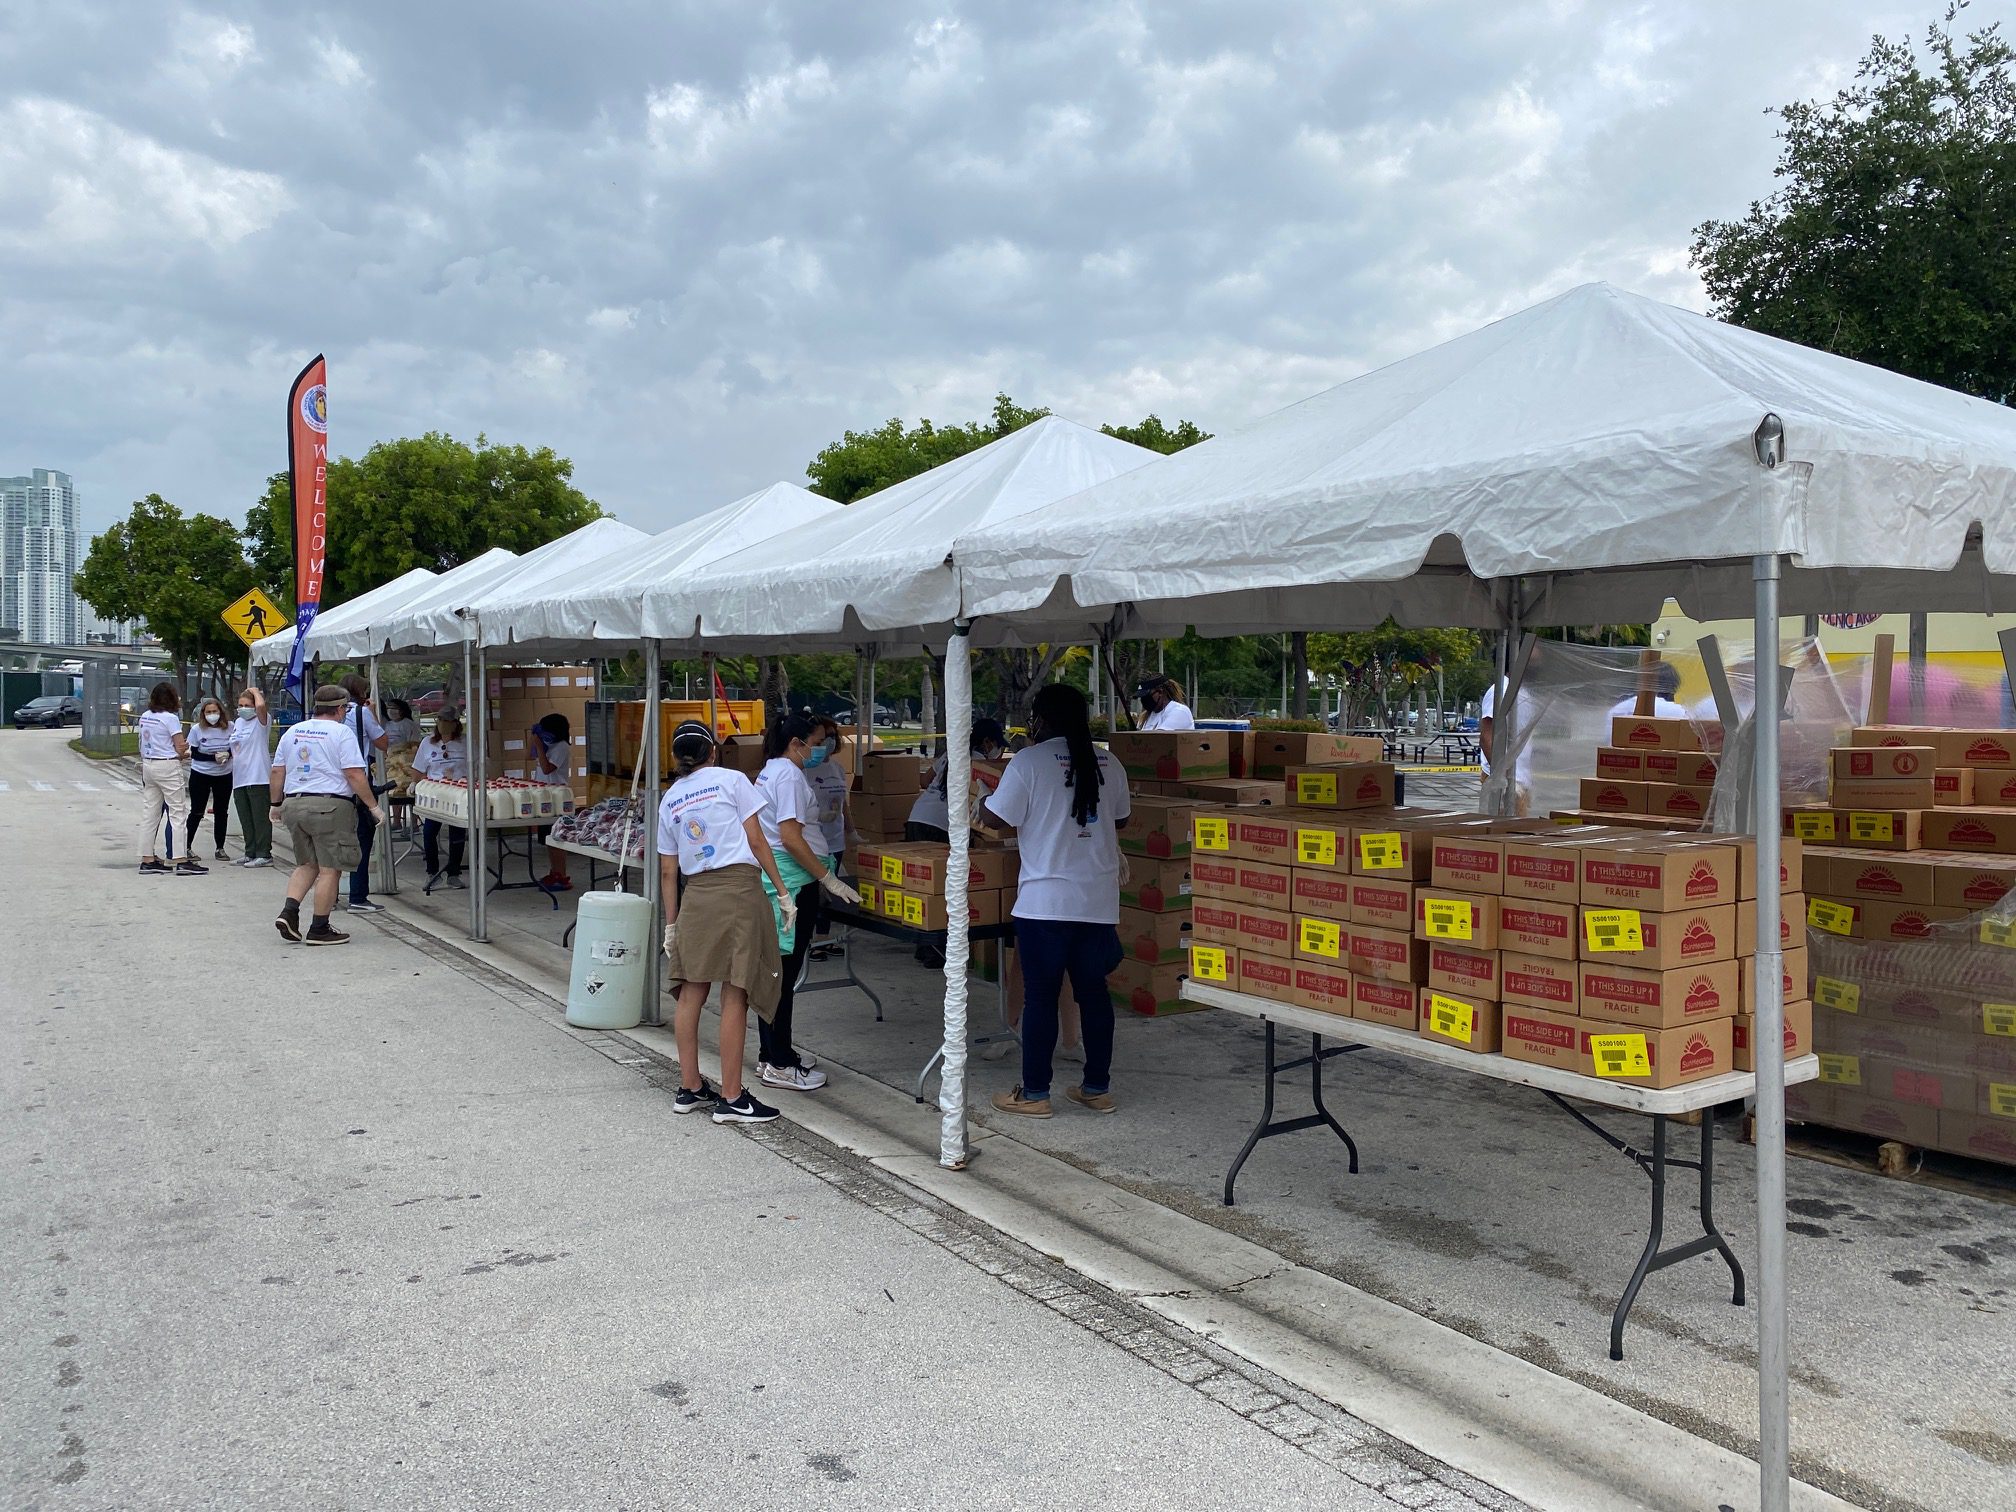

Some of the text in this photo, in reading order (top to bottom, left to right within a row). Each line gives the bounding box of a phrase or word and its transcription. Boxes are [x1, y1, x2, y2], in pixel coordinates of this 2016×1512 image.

[308, 443, 327, 596] WELCOME
[1330, 746, 1360, 759] Riveridge
[667, 785, 720, 810] Team Awesome
[1446, 852, 1488, 864] THIS SIDE UP
[1519, 860, 1564, 872] THIS SIDE UP
[1451, 871, 1481, 881] FRAGILE
[1599, 867, 1648, 878] THIS SIDE UP
[1524, 880, 1556, 891] FRAGILE
[1605, 887, 1640, 898] FRAGILE
[1308, 899, 1333, 909] FRAGILE
[1367, 910, 1392, 919] FRAGILE
[1513, 914, 1556, 928] THIS SIDE UP
[1251, 936, 1275, 947] FRAGILE
[1519, 933, 1550, 945] FRAGILE
[1444, 955, 1482, 970] THIS SIDE UP
[1522, 963, 1555, 976] FRAGILE
[1254, 981, 1278, 991] FRAGILE
[1304, 976, 1338, 989] THIS SIDE UP
[1448, 974, 1477, 987] FRAGILE
[1598, 981, 1615, 992] THIS
[1616, 984, 1634, 994] SIDE
[1636, 986, 1647, 995] UP
[1309, 993, 1334, 1003] FRAGILE
[1371, 1005, 1397, 1017] FRAGILE
[1604, 1001, 1640, 1014] FRAGILE
[1519, 1022, 1534, 1032] THIS
[1536, 1025, 1552, 1036] SIDE
[1553, 1029, 1564, 1038] UP
[1524, 1043, 1557, 1056] FRAGILE
